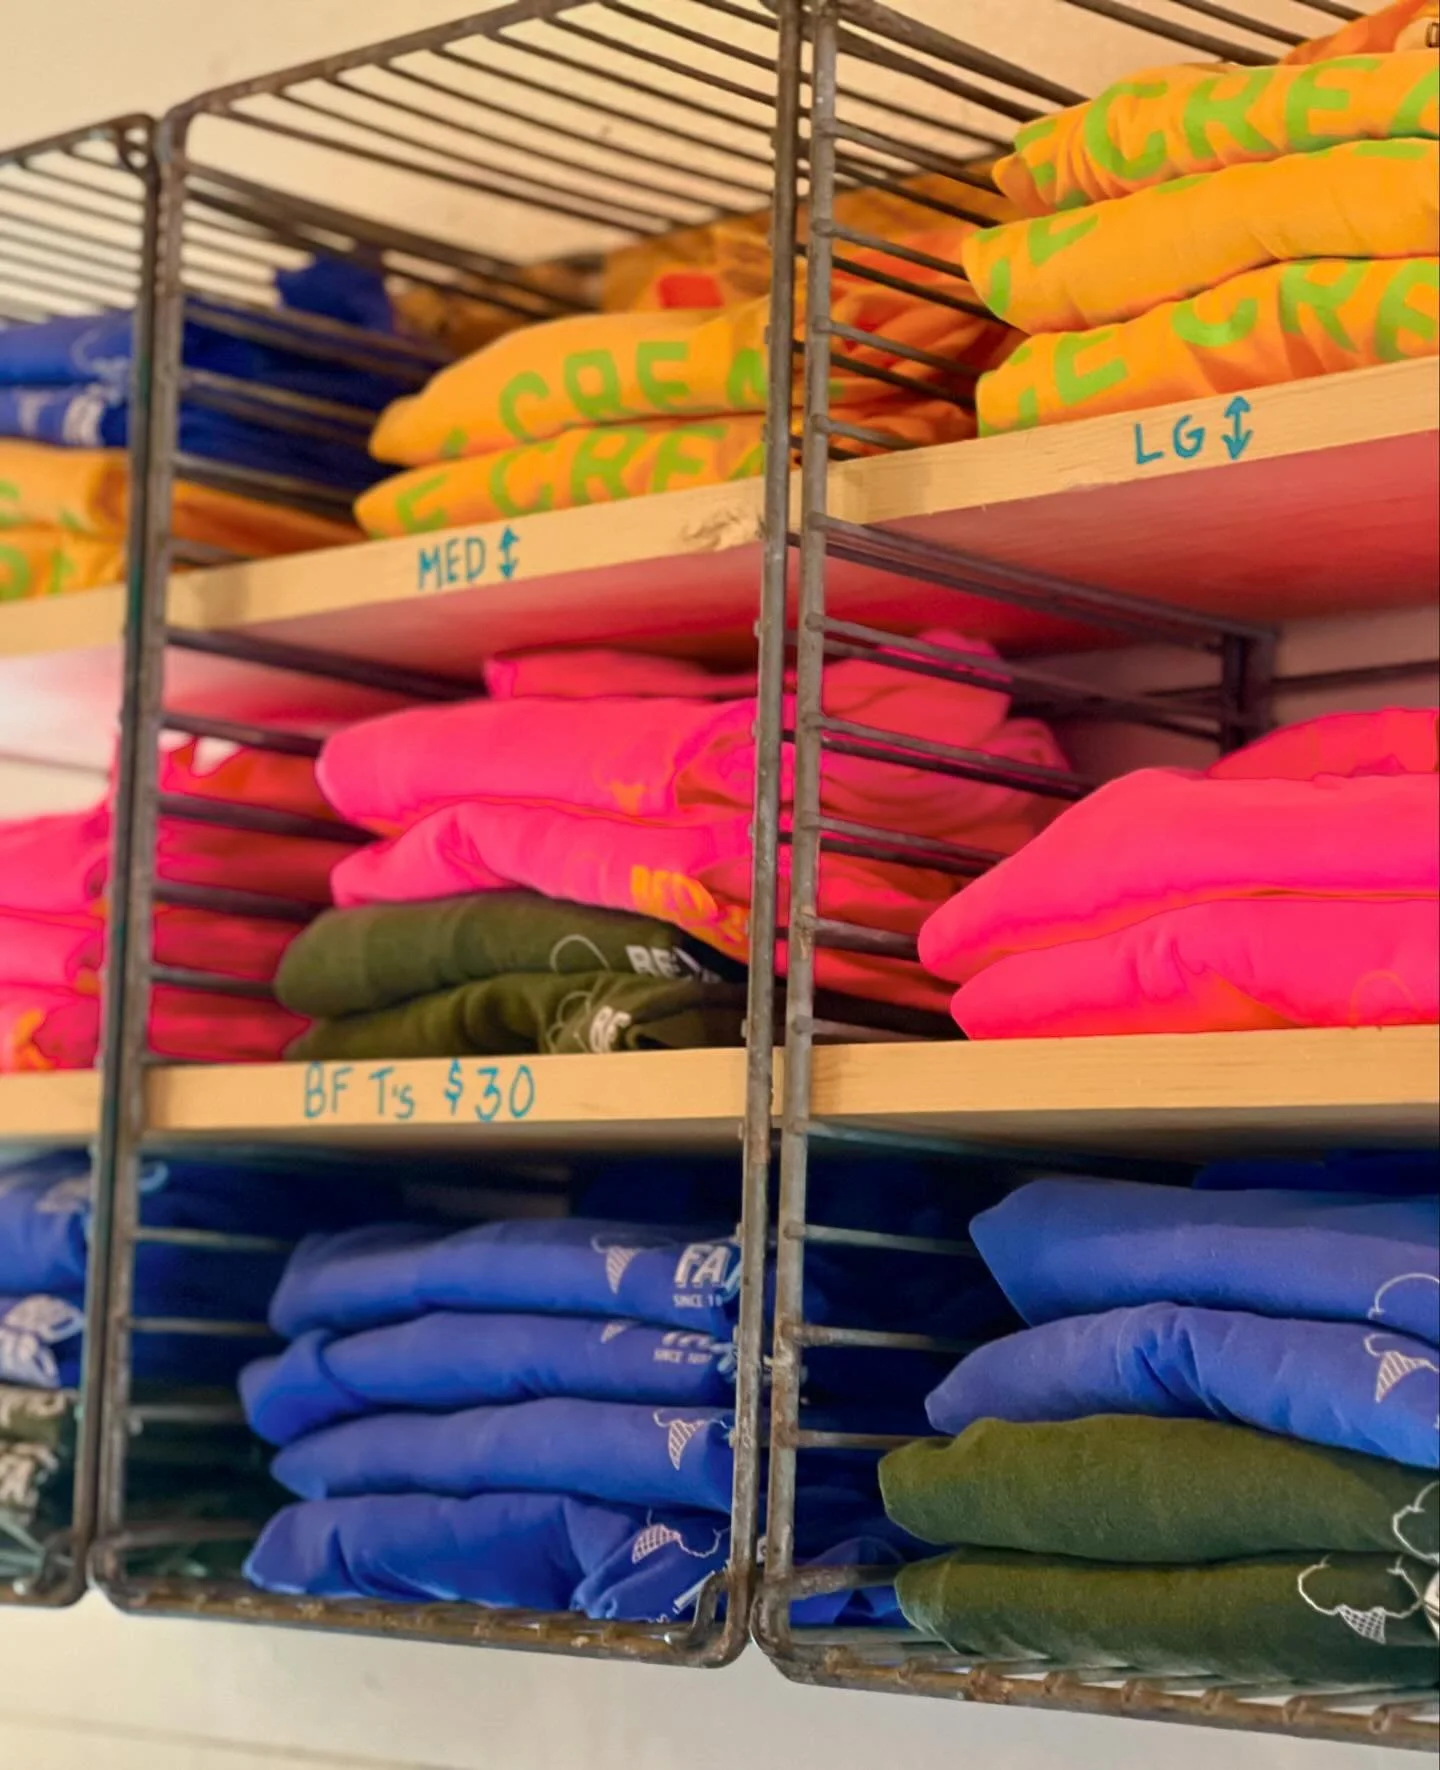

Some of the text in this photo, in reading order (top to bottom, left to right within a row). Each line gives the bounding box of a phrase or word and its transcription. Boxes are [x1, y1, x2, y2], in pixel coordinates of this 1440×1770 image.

[1134, 415, 1206, 466] LG
[417, 537, 486, 591] MED
[303, 1060, 353, 1118] BF
[444, 1057, 535, 1122] $30
